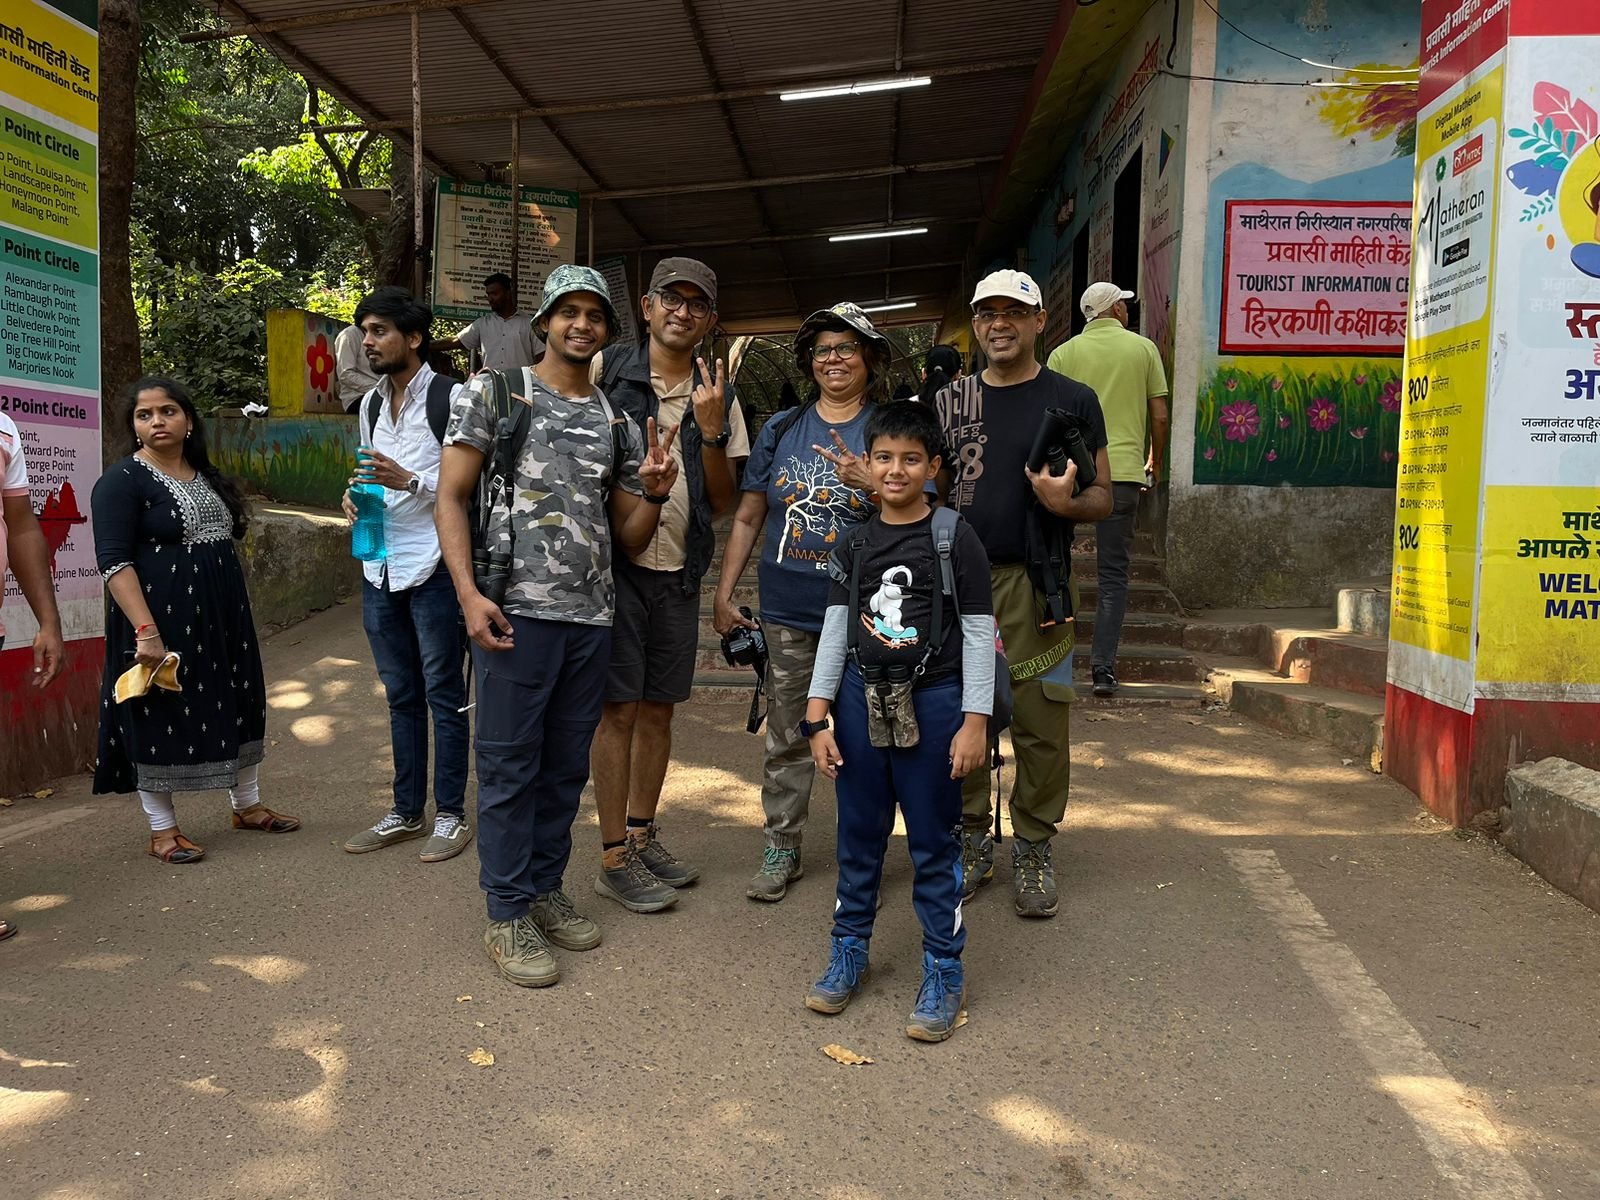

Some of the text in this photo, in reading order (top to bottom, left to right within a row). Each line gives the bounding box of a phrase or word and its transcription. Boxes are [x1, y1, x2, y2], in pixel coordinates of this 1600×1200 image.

[1426, 12, 1451, 52] प्रवासी
[1440, 17, 1482, 60] Information
[10, 50, 70, 90] Information
[26, 36, 67, 71] माहिती
[70, 54, 90, 83] केंद्र
[1435, 91, 1481, 129] Digital Matheran
[5, 116, 80, 161] Point Circle
[1441, 115, 1472, 141] Mobile App
[3, 165, 76, 201] Landscape Point
[7, 152, 34, 173] Point,
[35, 163, 64, 183] Louisa
[65, 174, 89, 194] Point,
[0, 180, 80, 217] Honeymoon Point,
[11, 197, 69, 226] Malang Point
[1239, 209, 1292, 231] माथेरान
[1295, 211, 1355, 232] गिरीस्थान
[5, 238, 80, 273] Point Circle
[1264, 235, 1329, 264] प्रवासी
[1330, 235, 1385, 268] माहिती
[6, 272, 76, 298] Alexandar Point
[1236, 274, 1295, 292] TOURIST
[1302, 275, 1391, 293] INFORMATION
[5, 286, 77, 313] Rambaugh Point
[1, 301, 81, 327] Little Chowk Point
[1241, 297, 1334, 339] हिरकणी
[0, 328, 81, 353] One Tree Hill Point
[6, 316, 76, 339] Belvedere Point
[6, 344, 77, 366] Big Chowk Point
[8, 358, 75, 379] Marjories Nook
[1408, 375, 1428, 405] १००
[12, 397, 49, 415] Point
[52, 402, 87, 420] Circle
[1521, 416, 1574, 428] जन्मानंतर
[19, 430, 40, 443] oint,
[1530, 431, 1597, 443] त्याने बाळाची
[21, 444, 76, 458] dward Point
[26, 460, 75, 473] eorge Point
[28, 474, 45, 486] ape
[1399, 524, 1419, 551] १०८
[1517, 533, 1591, 559] आपले
[78, 566, 100, 577] Nook
[1538, 572, 1600, 593] WEL
